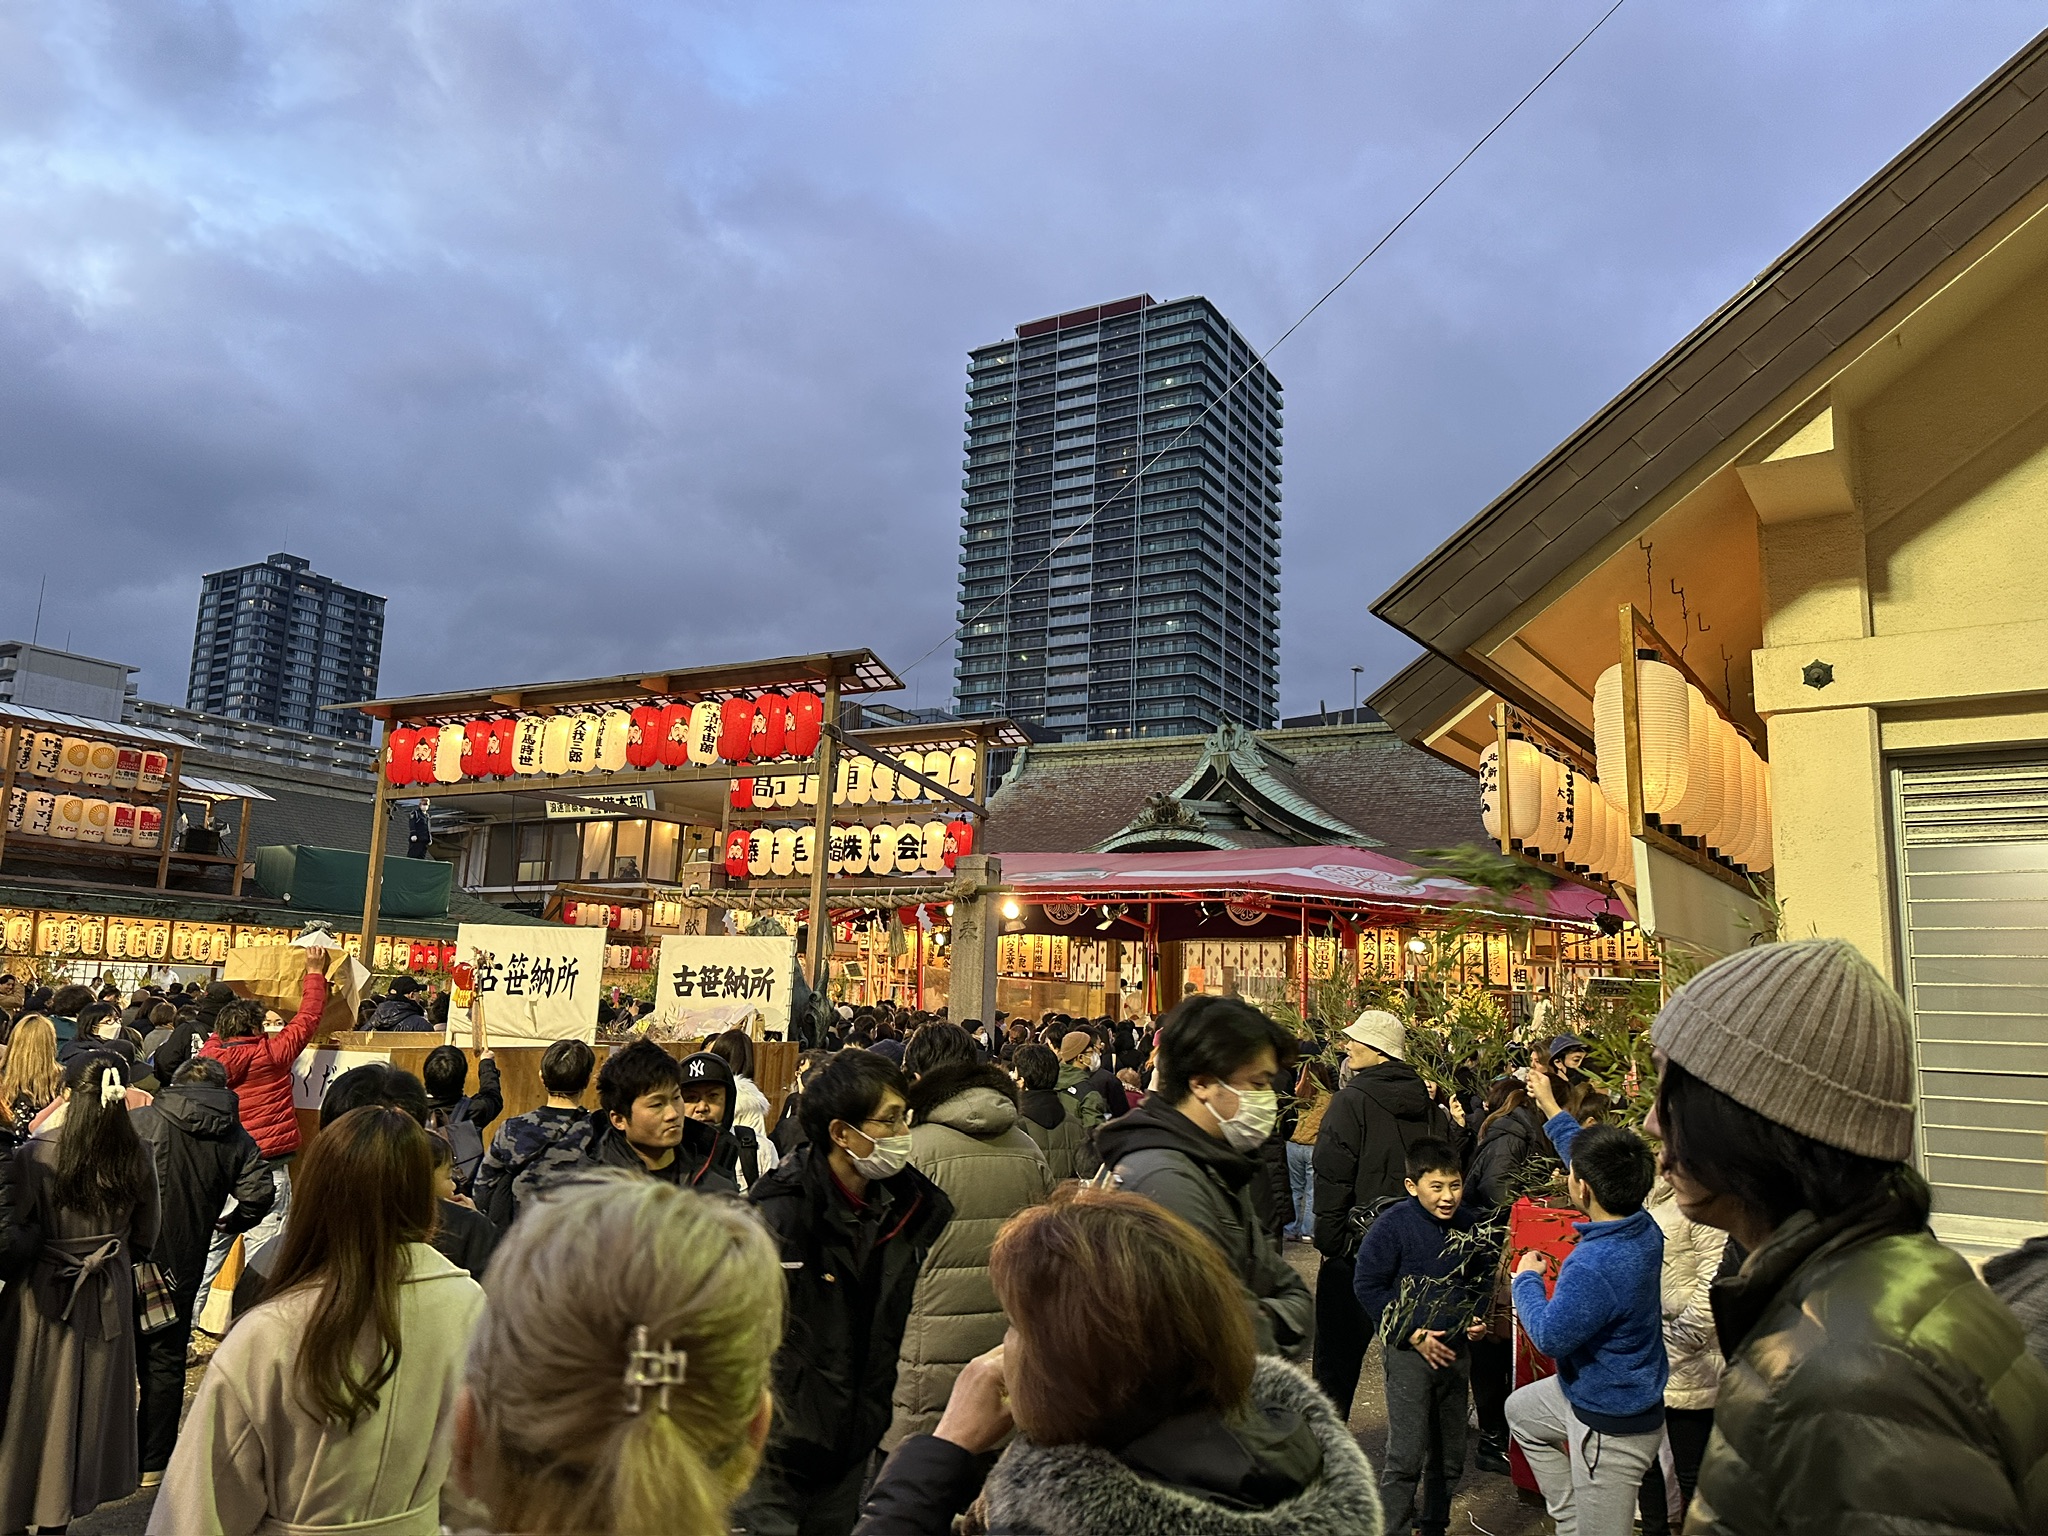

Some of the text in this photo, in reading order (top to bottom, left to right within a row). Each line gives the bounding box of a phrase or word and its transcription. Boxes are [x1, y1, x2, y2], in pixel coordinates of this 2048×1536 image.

[37, 738, 54, 770] ヤマト
[518, 723, 538, 766] 有馬時世
[569, 720, 586, 762] 久我三郎
[1488, 753, 1498, 792] 北新地
[33, 797, 49, 829] ヤマト
[958, 918, 978, 942] 奉
[480, 952, 579, 1001] 古笹納所
[673, 964, 776, 1003] 古笹納所
[689, 1059, 705, 1077] NY
